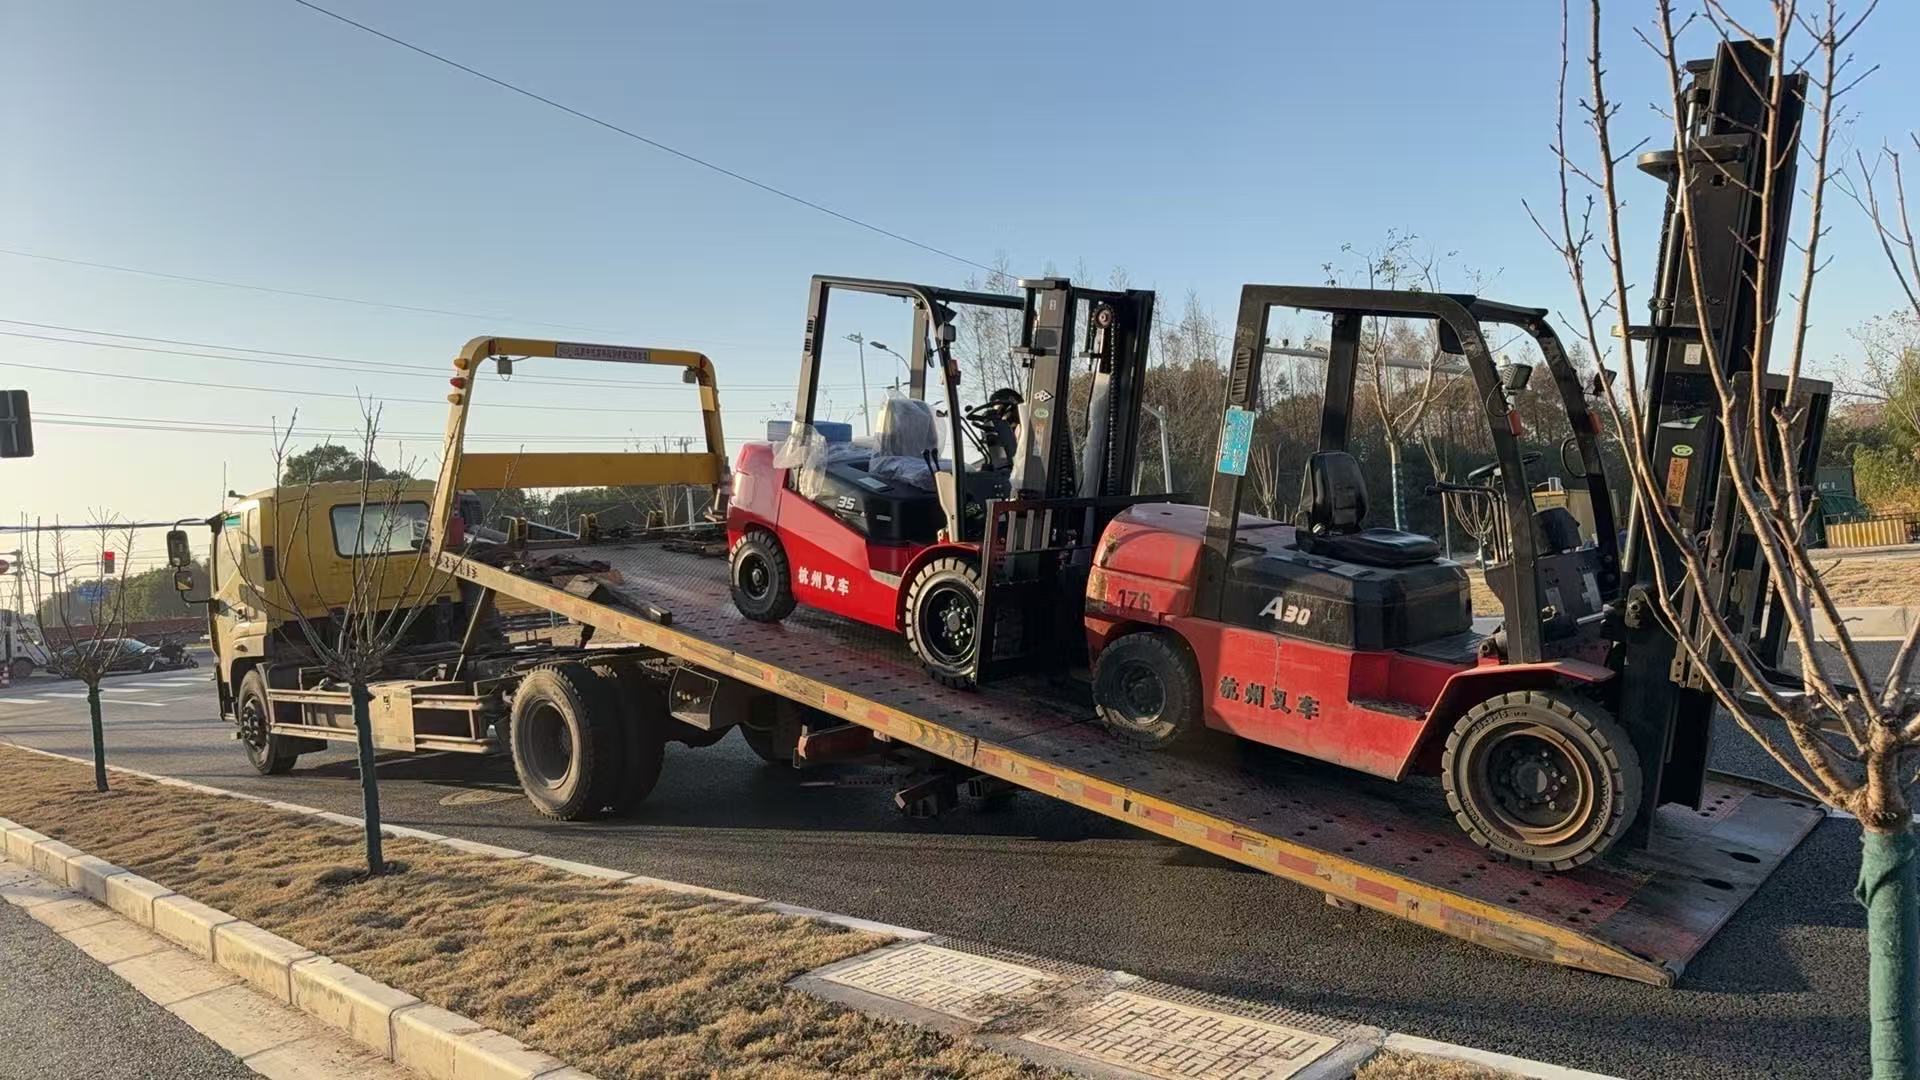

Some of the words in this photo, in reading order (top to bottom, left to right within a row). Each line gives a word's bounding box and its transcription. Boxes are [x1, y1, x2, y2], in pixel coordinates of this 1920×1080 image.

[837, 495, 856, 509] 35
[798, 566, 850, 596] 杭州叉车
[1116, 589, 1152, 612] 176
[1259, 596, 1311, 625] A30
[1218, 676, 1320, 720] 杭州叉车
